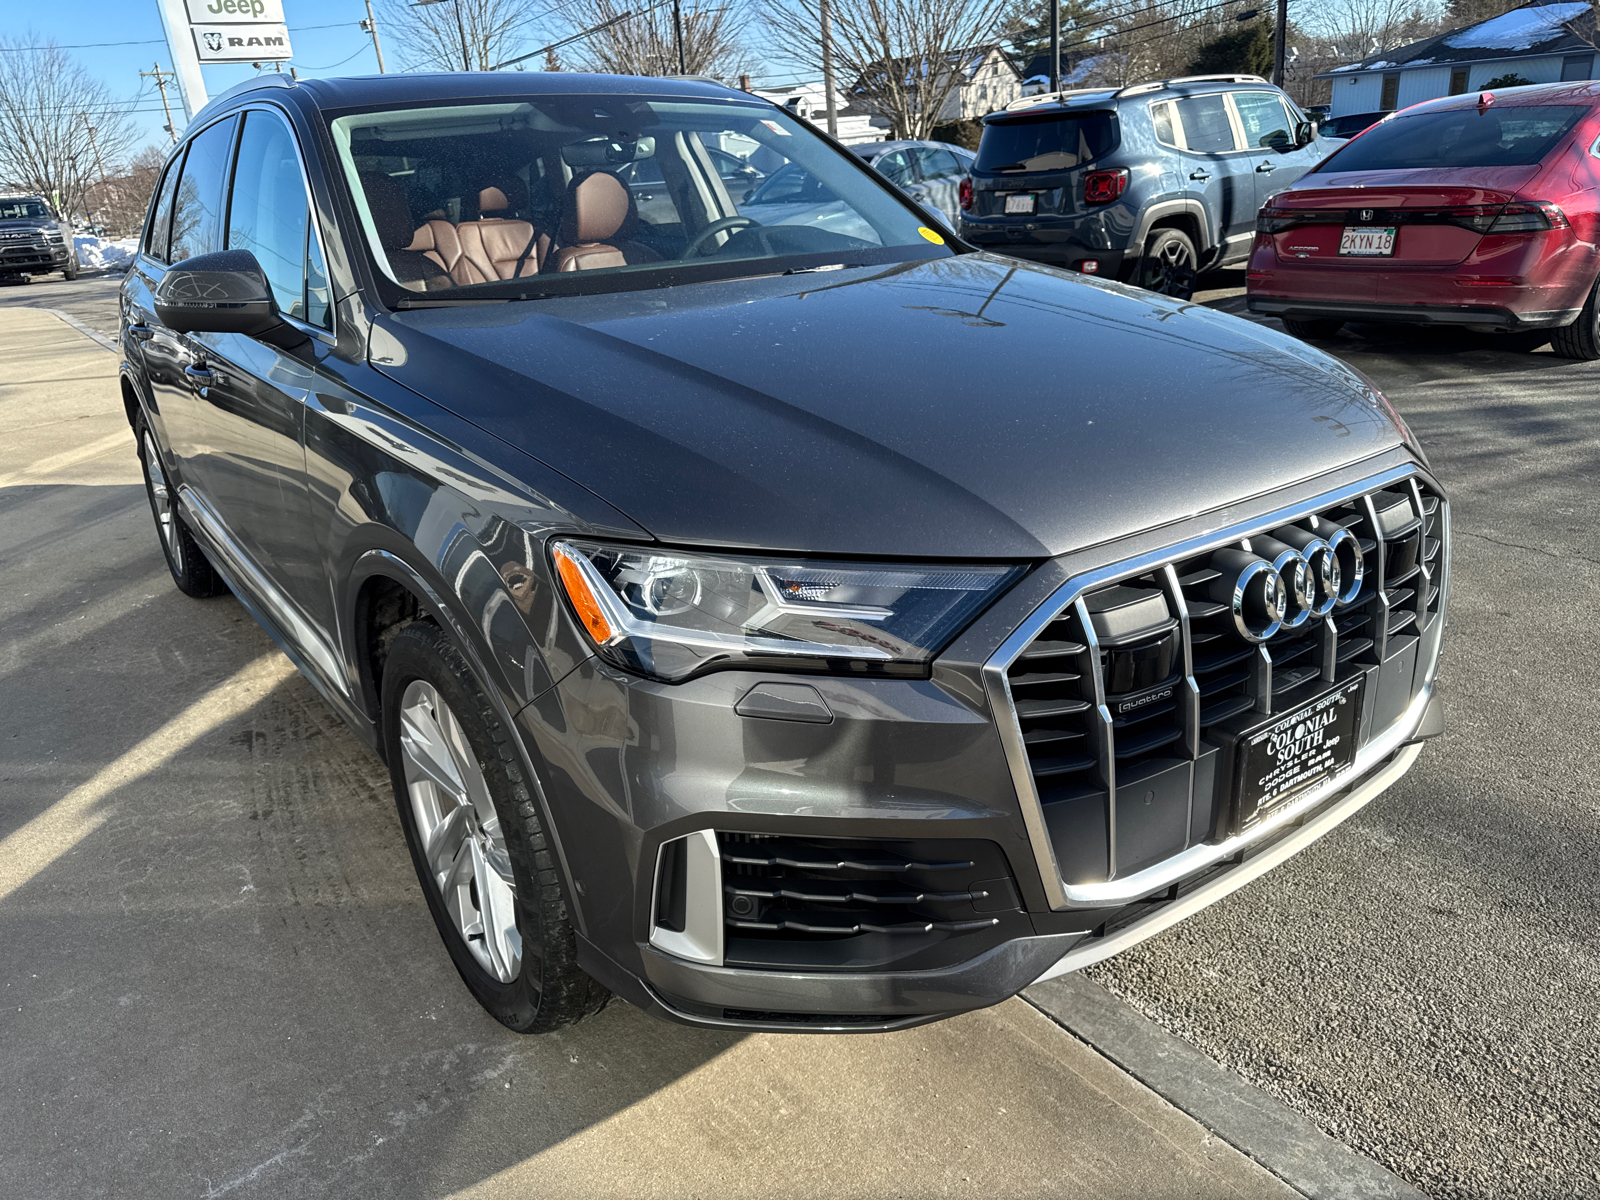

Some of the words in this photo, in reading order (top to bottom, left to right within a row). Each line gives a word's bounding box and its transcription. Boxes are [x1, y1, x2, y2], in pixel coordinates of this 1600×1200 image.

[207, 0, 265, 18] Jeep
[227, 37, 284, 47] RAM
[1341, 234, 1374, 249] 2KYN
[1375, 234, 1393, 249] 18
[1122, 689, 1172, 710] quattro
[1266, 707, 1337, 755] COLONIAL
[1276, 728, 1324, 766] SOUTH
[1258, 748, 1317, 786] CHRYSLER
[1322, 735, 1340, 749] Jeep
[1264, 765, 1301, 792] DODGE
[1308, 749, 1331, 766] RAM
[1272, 788, 1278, 796] 6
